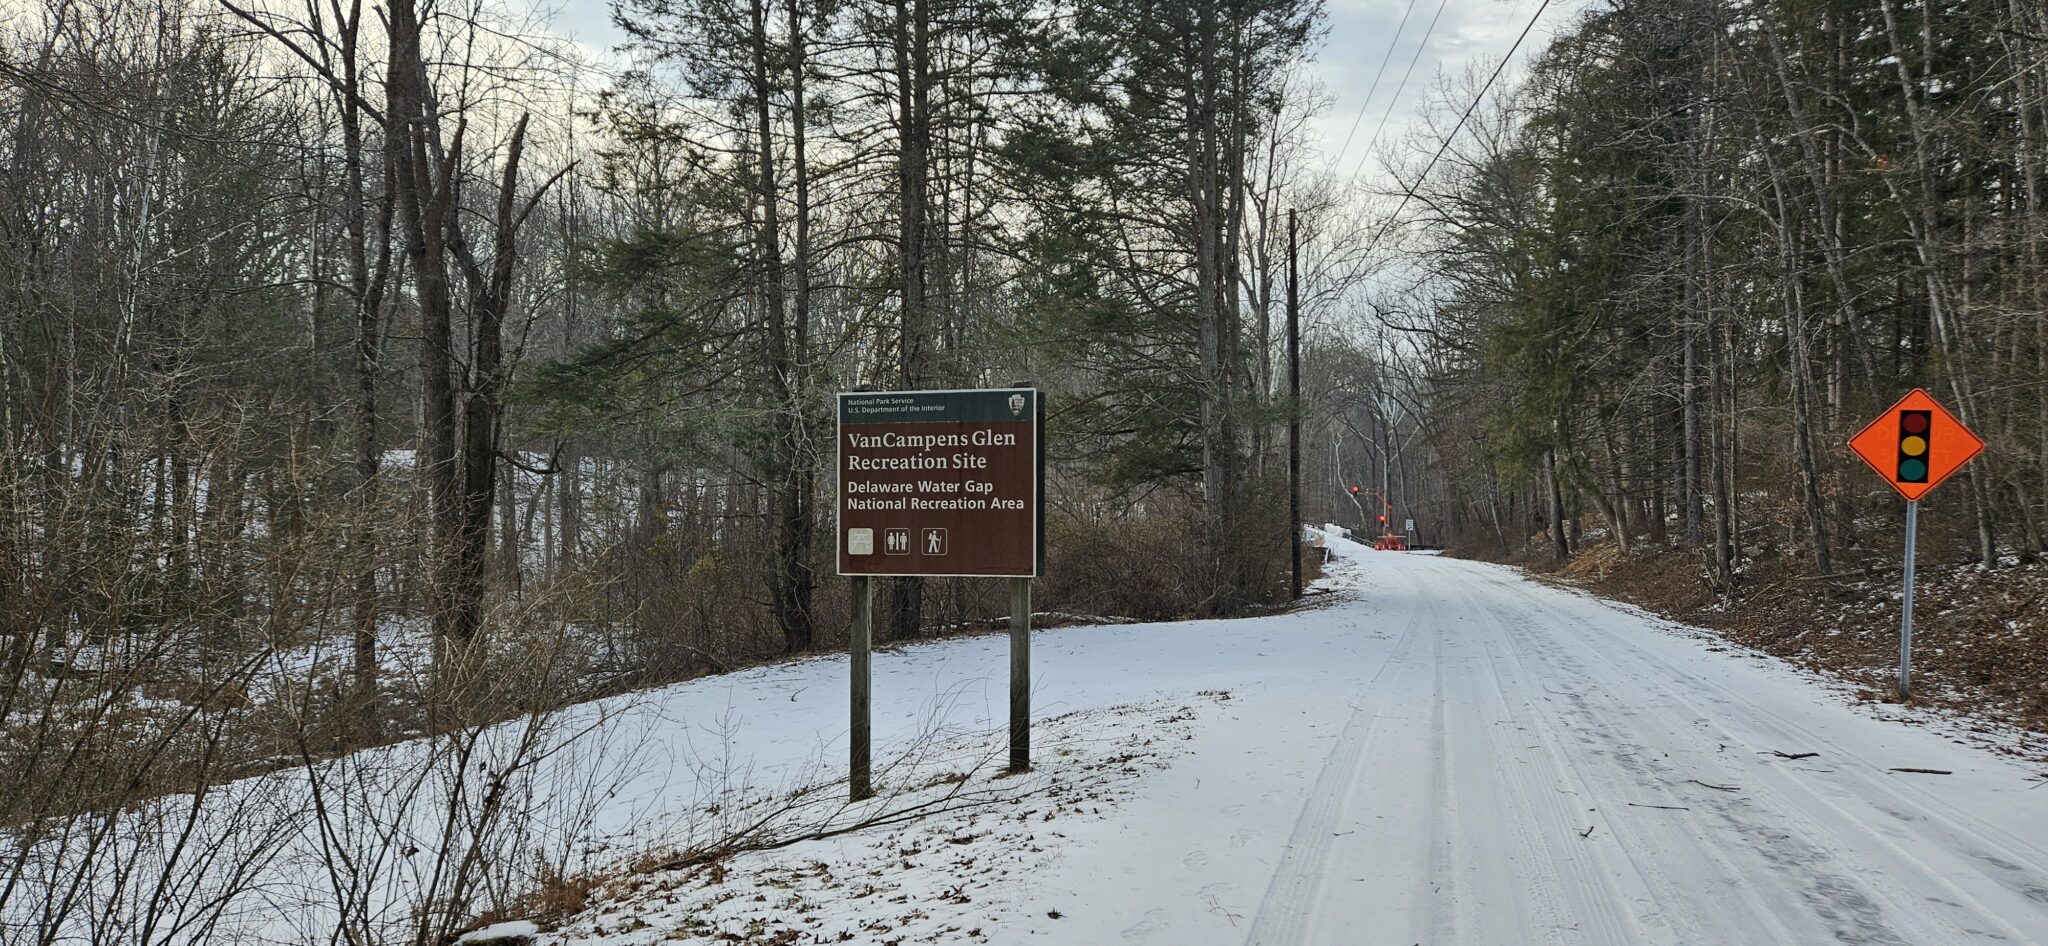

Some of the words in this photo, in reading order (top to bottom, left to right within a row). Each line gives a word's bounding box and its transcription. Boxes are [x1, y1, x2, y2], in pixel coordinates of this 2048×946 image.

[848, 432, 968, 450] VanCampens
[972, 430, 1015, 445] Glen
[848, 454, 947, 470] Recreation
[953, 454, 986, 468] Site
[848, 481, 913, 493] Delaware
[918, 481, 960, 492] Water
[965, 481, 993, 494] Gap
[848, 498, 905, 509] National
[912, 498, 985, 509] Recreation
[991, 498, 1024, 509] Area
